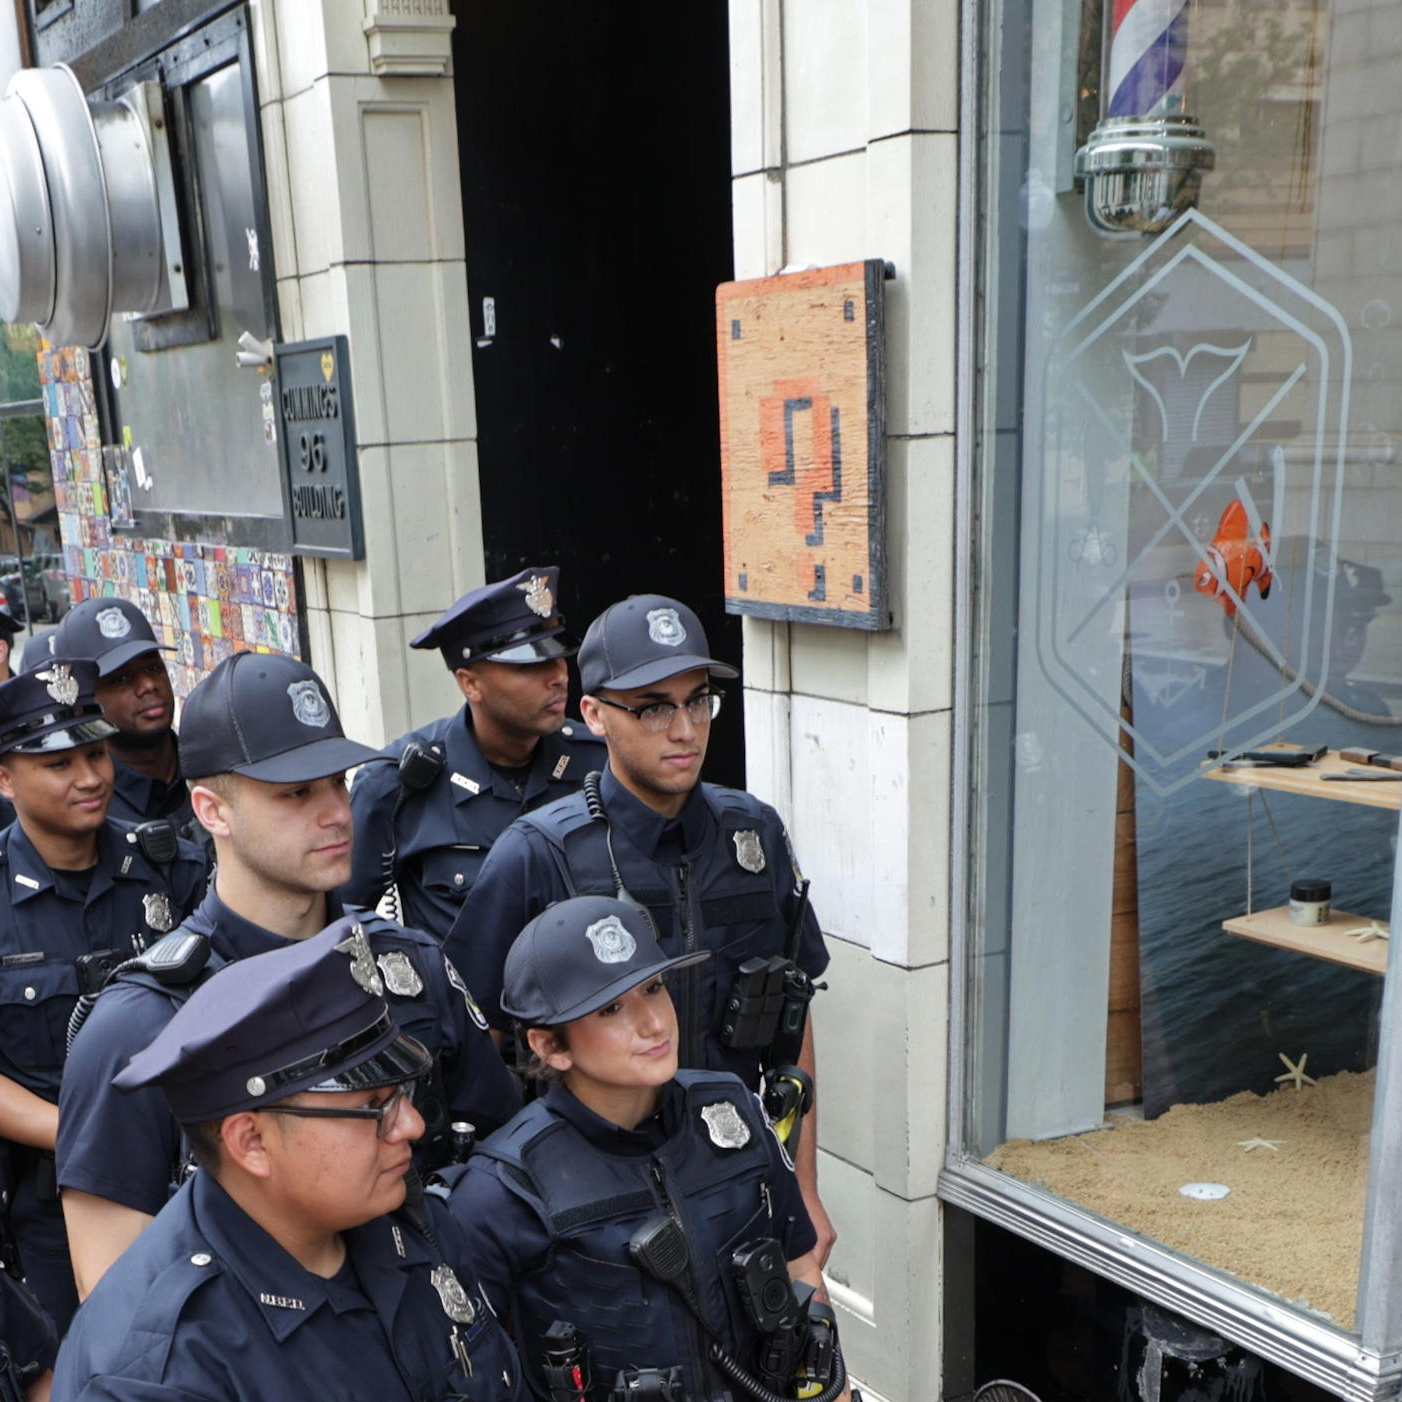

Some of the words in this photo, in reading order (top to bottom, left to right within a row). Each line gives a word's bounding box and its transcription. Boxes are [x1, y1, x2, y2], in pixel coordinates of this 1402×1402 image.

[282, 383, 338, 421] CUMMINGS
[300, 430, 329, 472] 96
[293, 485, 346, 520] BUILDING
